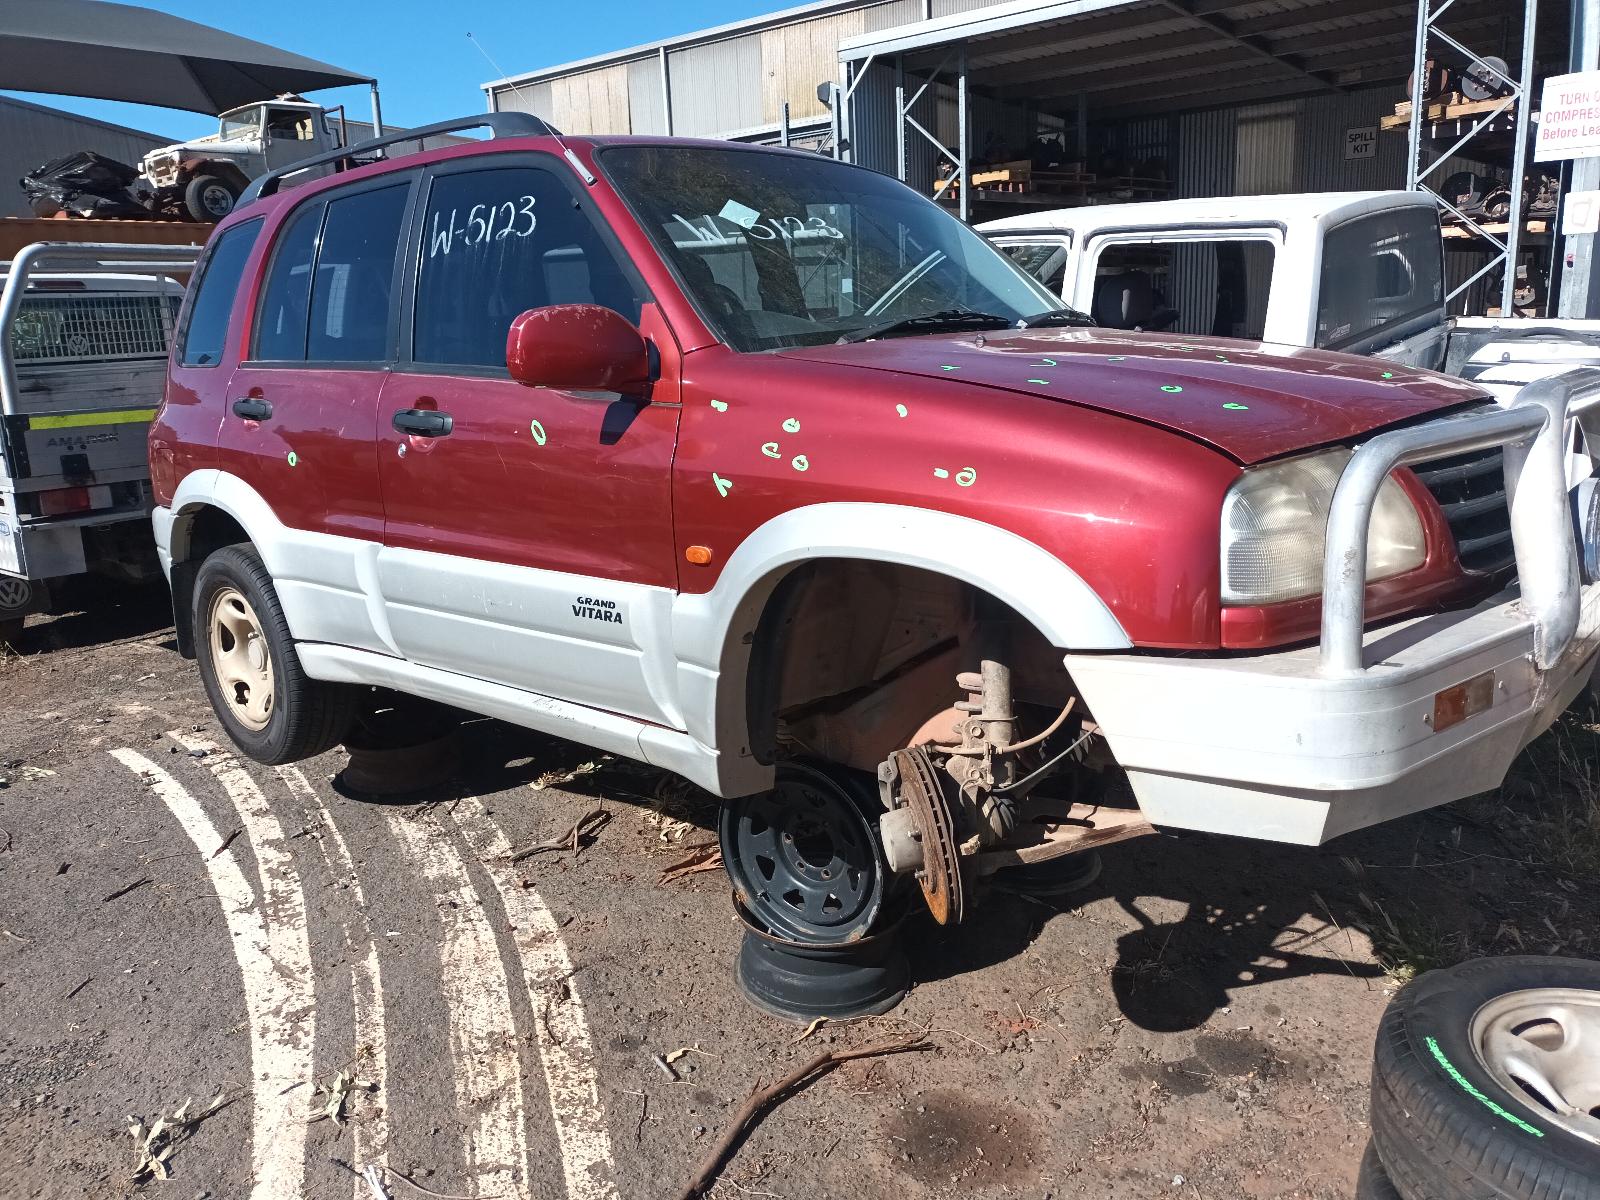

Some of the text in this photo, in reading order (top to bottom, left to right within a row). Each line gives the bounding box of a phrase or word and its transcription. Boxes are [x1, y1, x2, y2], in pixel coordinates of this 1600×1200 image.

[1560, 92, 1589, 105] TURN
[1348, 132, 1375, 143] SPILL
[1543, 128, 1578, 140] Before
[1353, 143, 1370, 154] KIT
[46, 432, 119, 448] AMAROK
[577, 596, 616, 610] GRAND
[572, 604, 623, 624] VITARA
